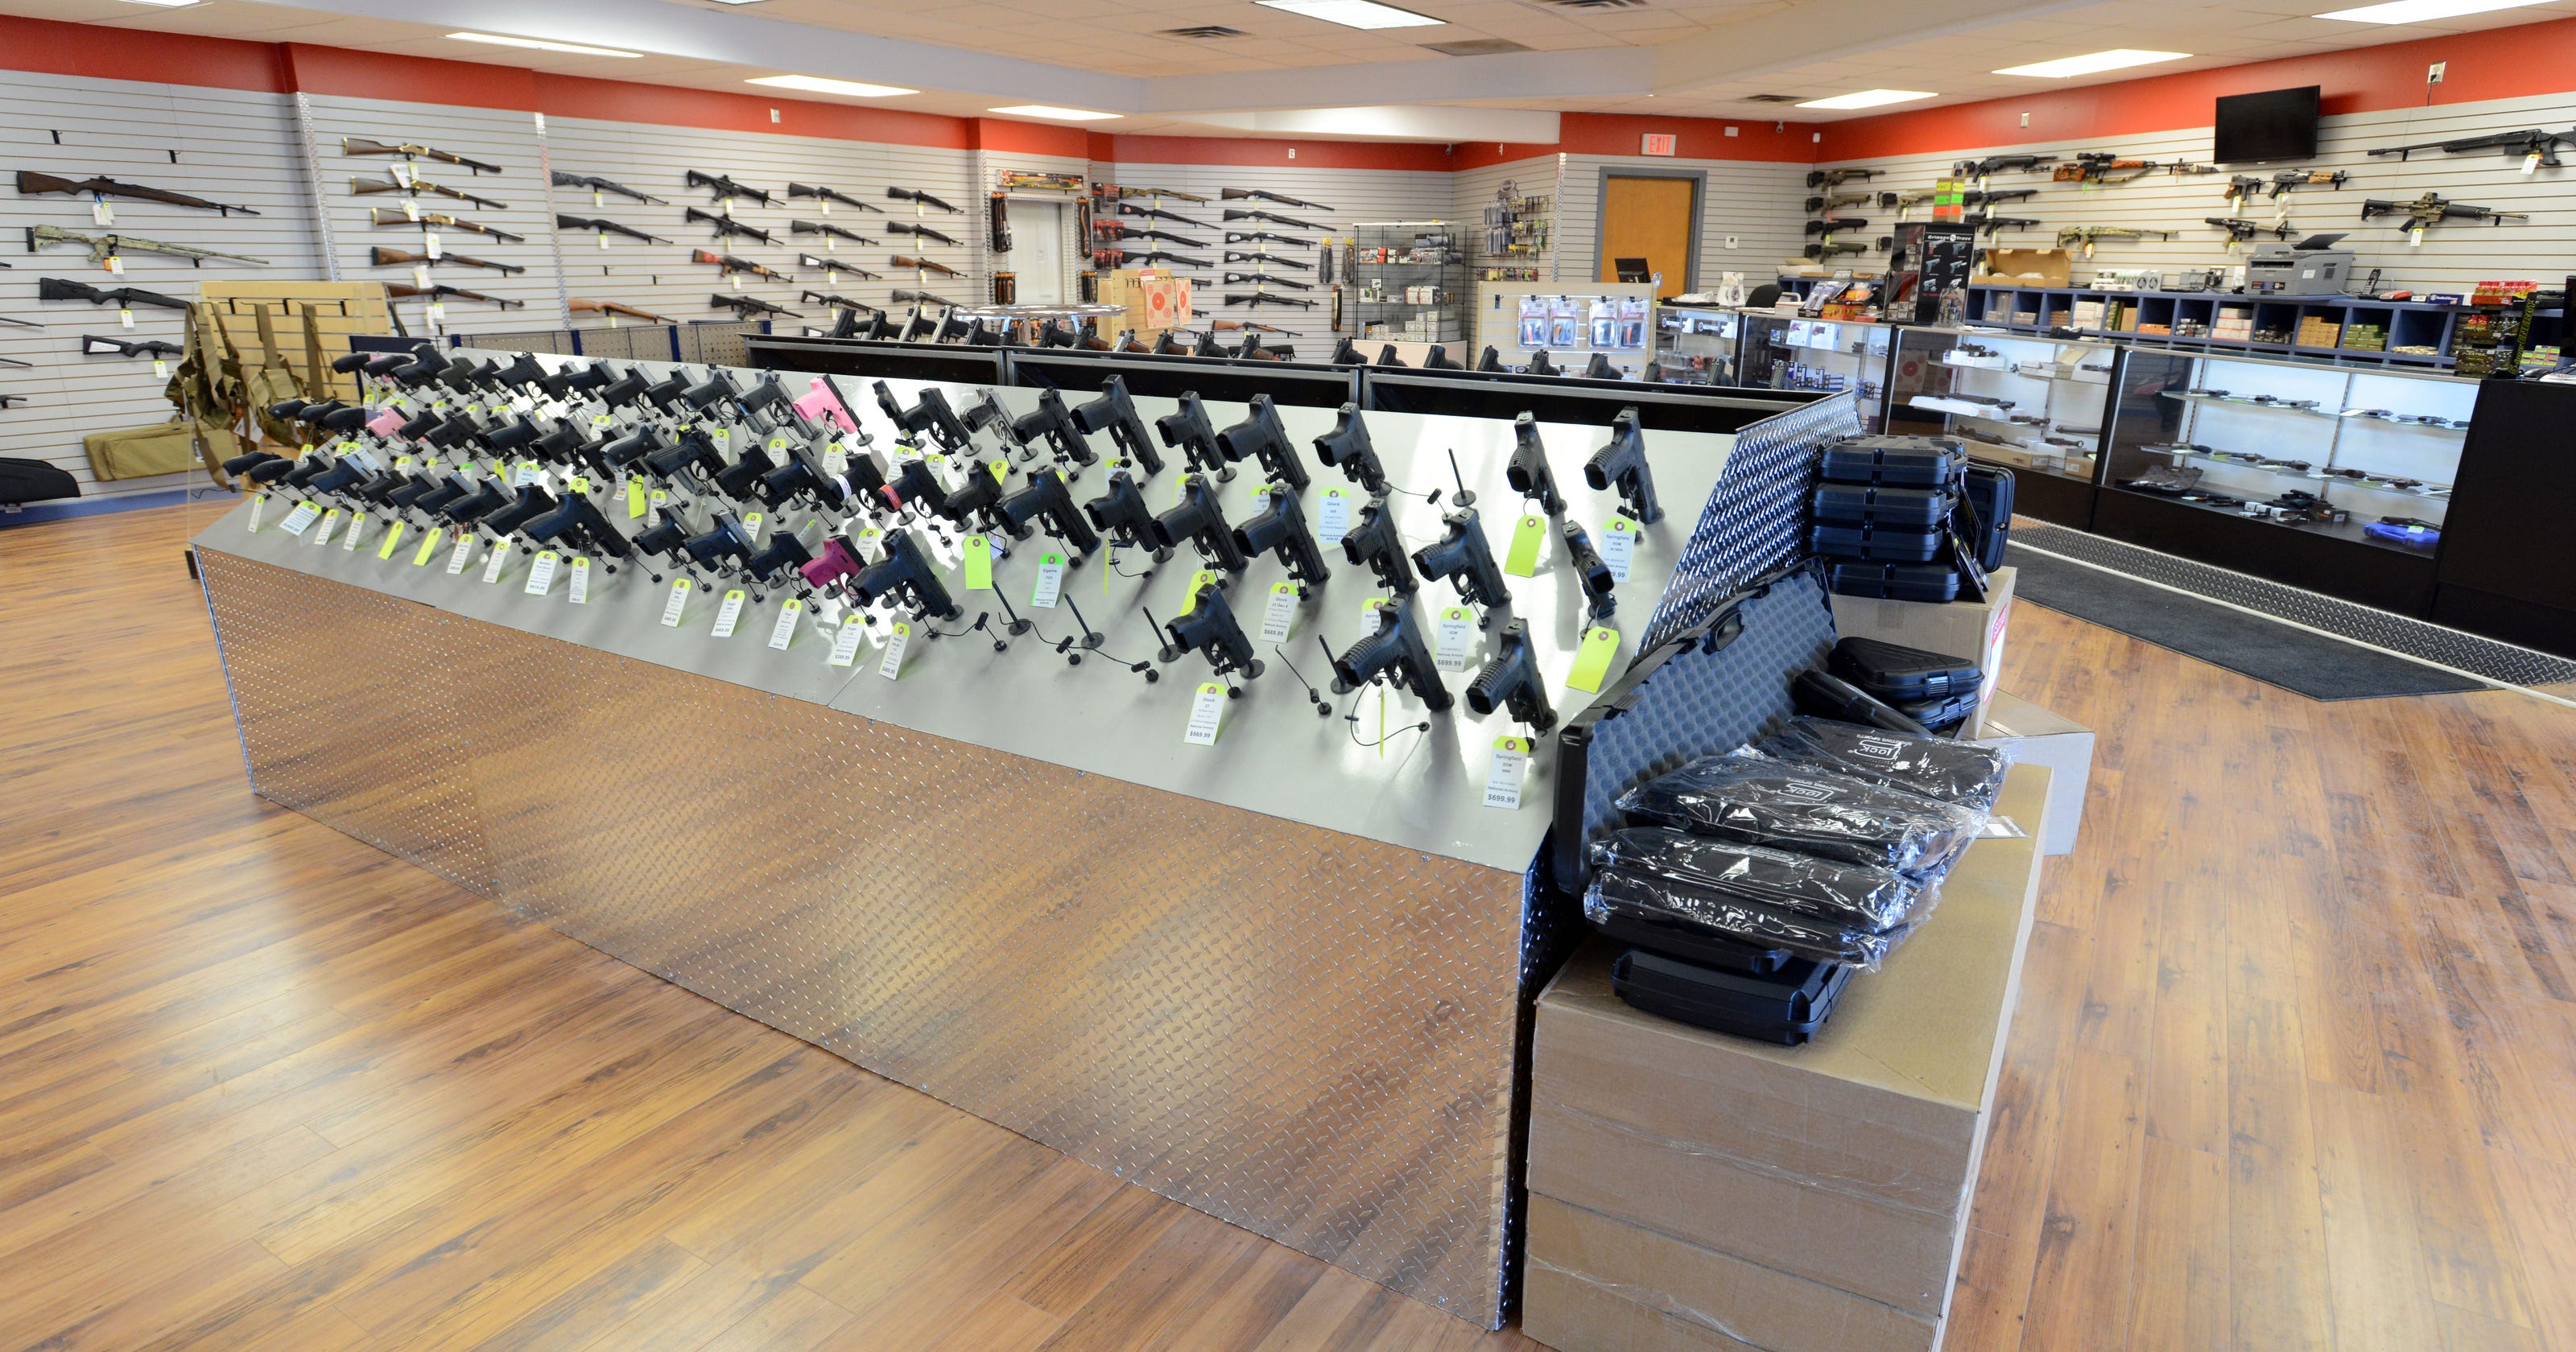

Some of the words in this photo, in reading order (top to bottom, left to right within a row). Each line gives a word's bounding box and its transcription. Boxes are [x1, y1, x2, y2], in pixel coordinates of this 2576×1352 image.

[1648, 134, 1672, 155] EXIT
[2516, 299, 2536, 345] ENERGY
[1496, 753, 1522, 762] Springfield
[1488, 793, 1516, 804] $699.99
